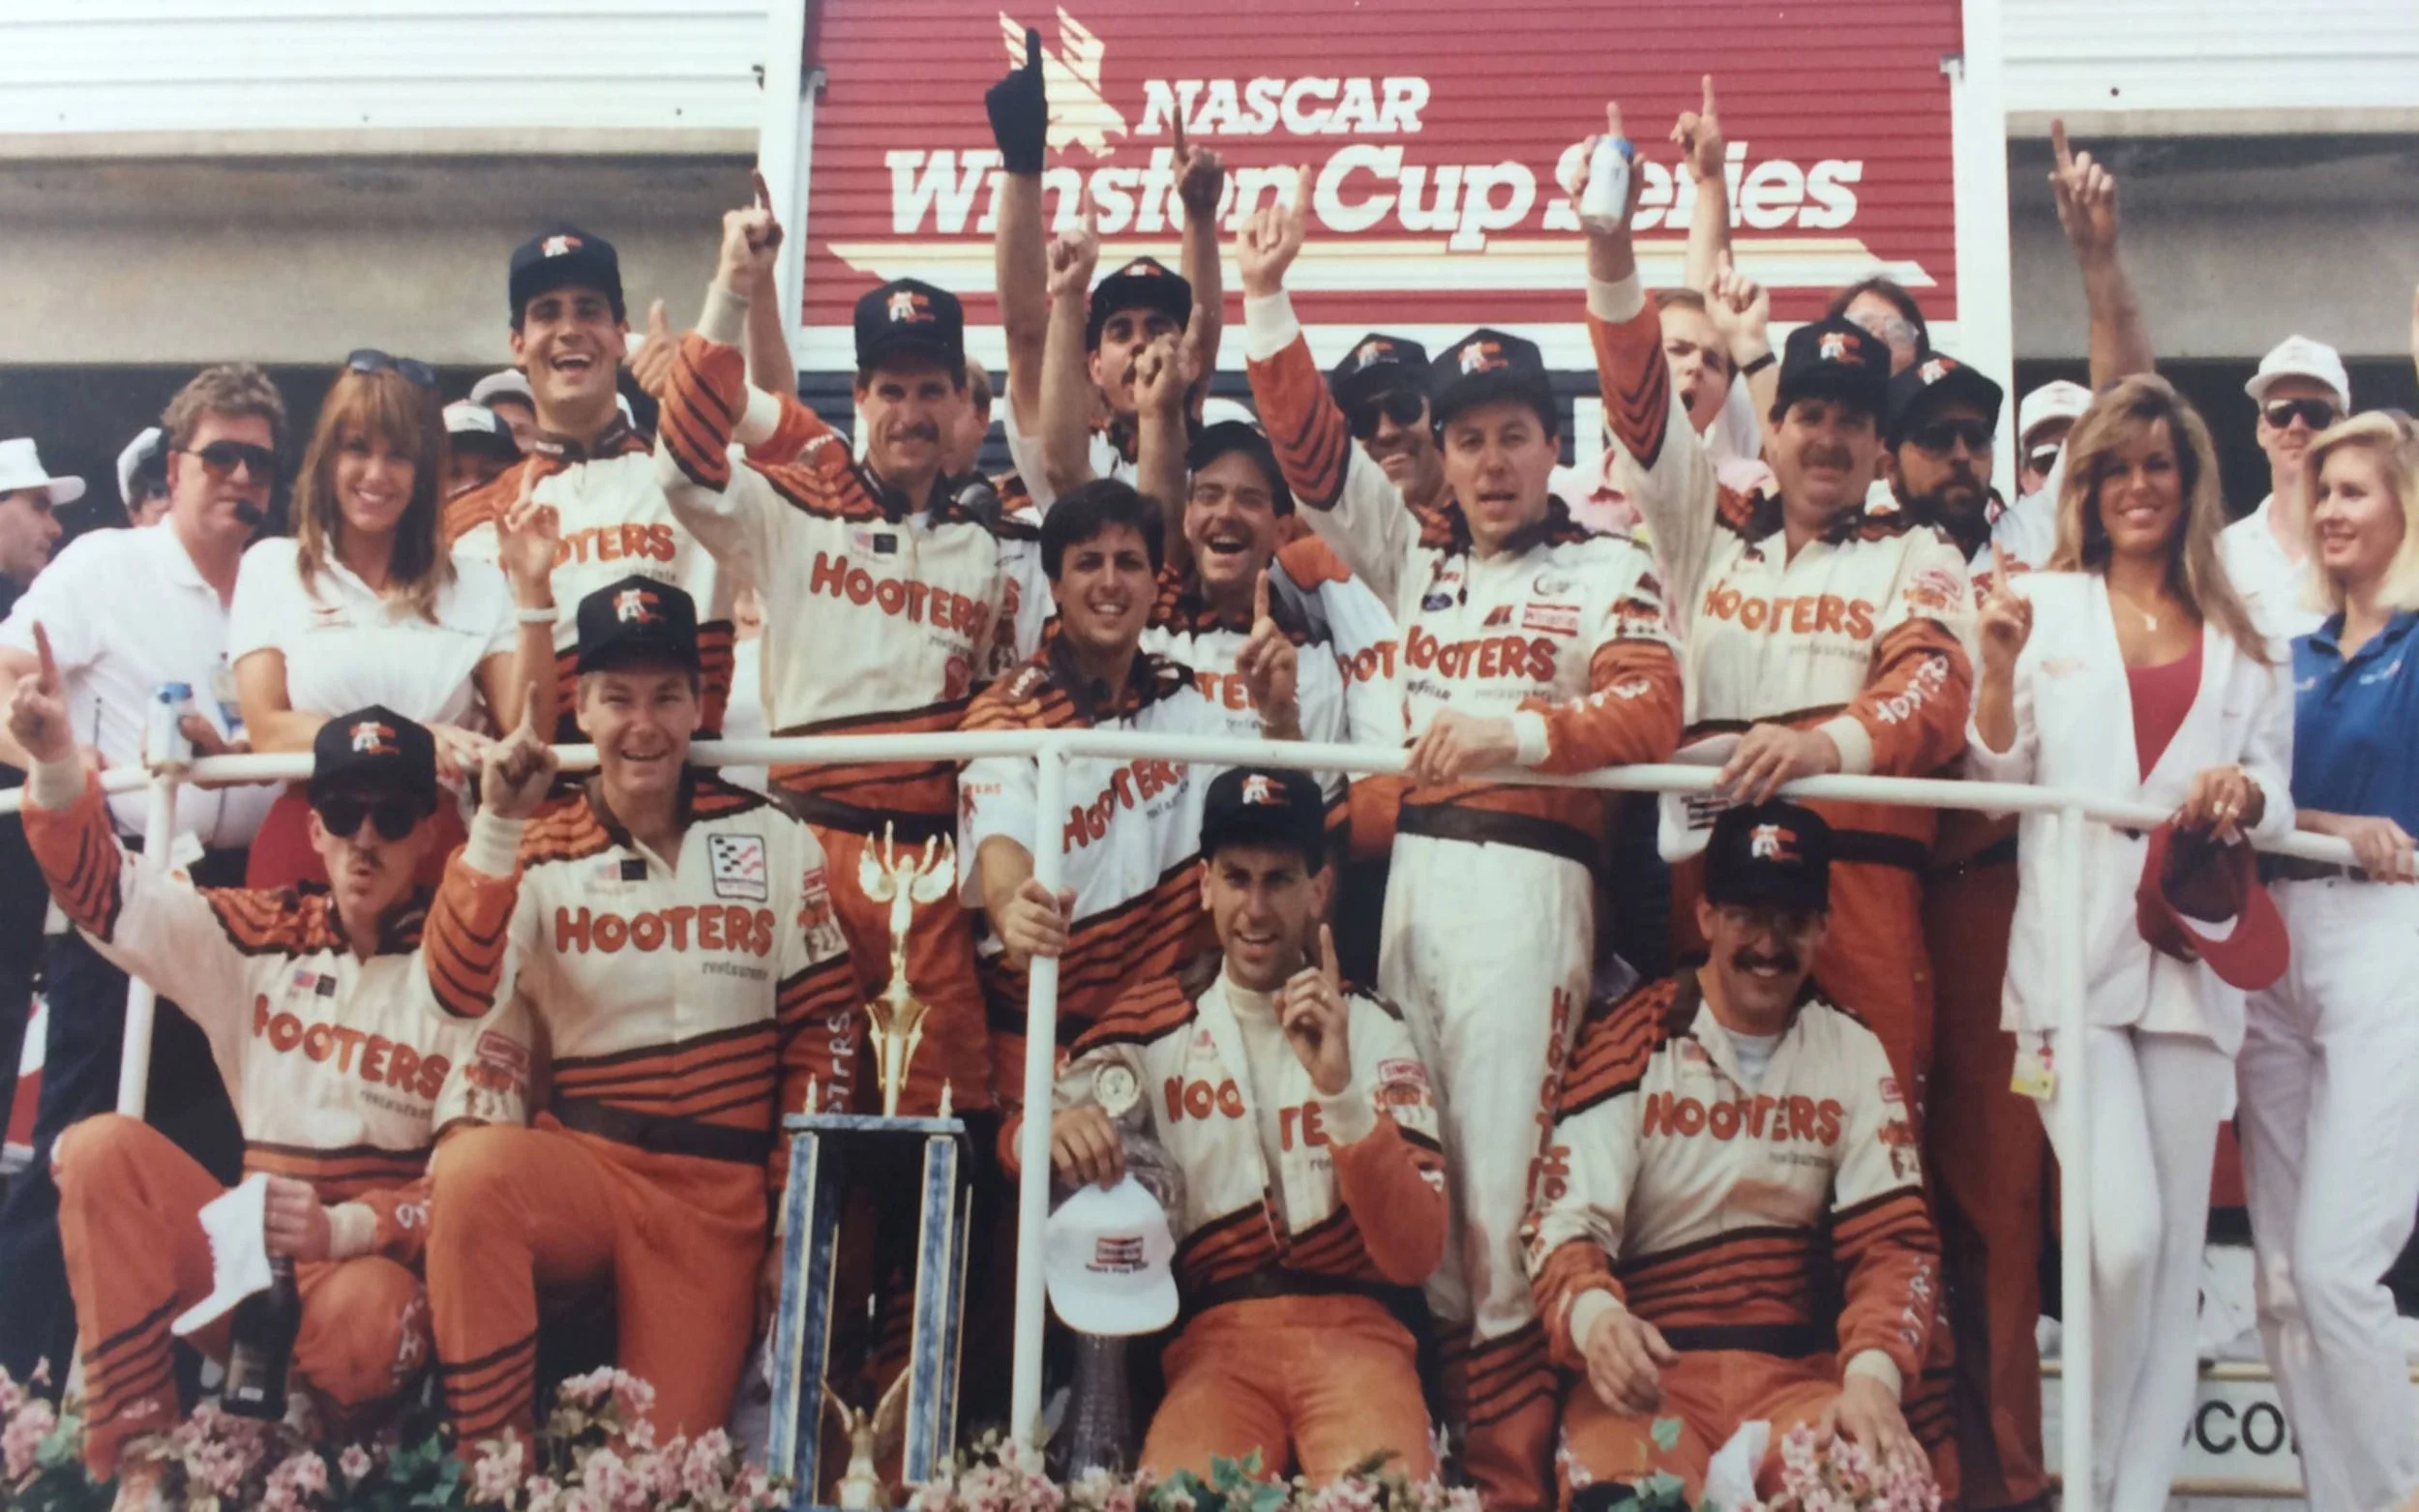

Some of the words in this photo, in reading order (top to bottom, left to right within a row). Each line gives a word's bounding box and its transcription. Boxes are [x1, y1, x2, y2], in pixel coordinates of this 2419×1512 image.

[1135, 76, 1430, 135] NASCAR
[1314, 145, 1537, 252] Cup
[555, 904, 777, 958] HOOTERS
[1642, 1090, 1844, 1147] HOOTERS
[2183, 1399, 2301, 1455] CO
